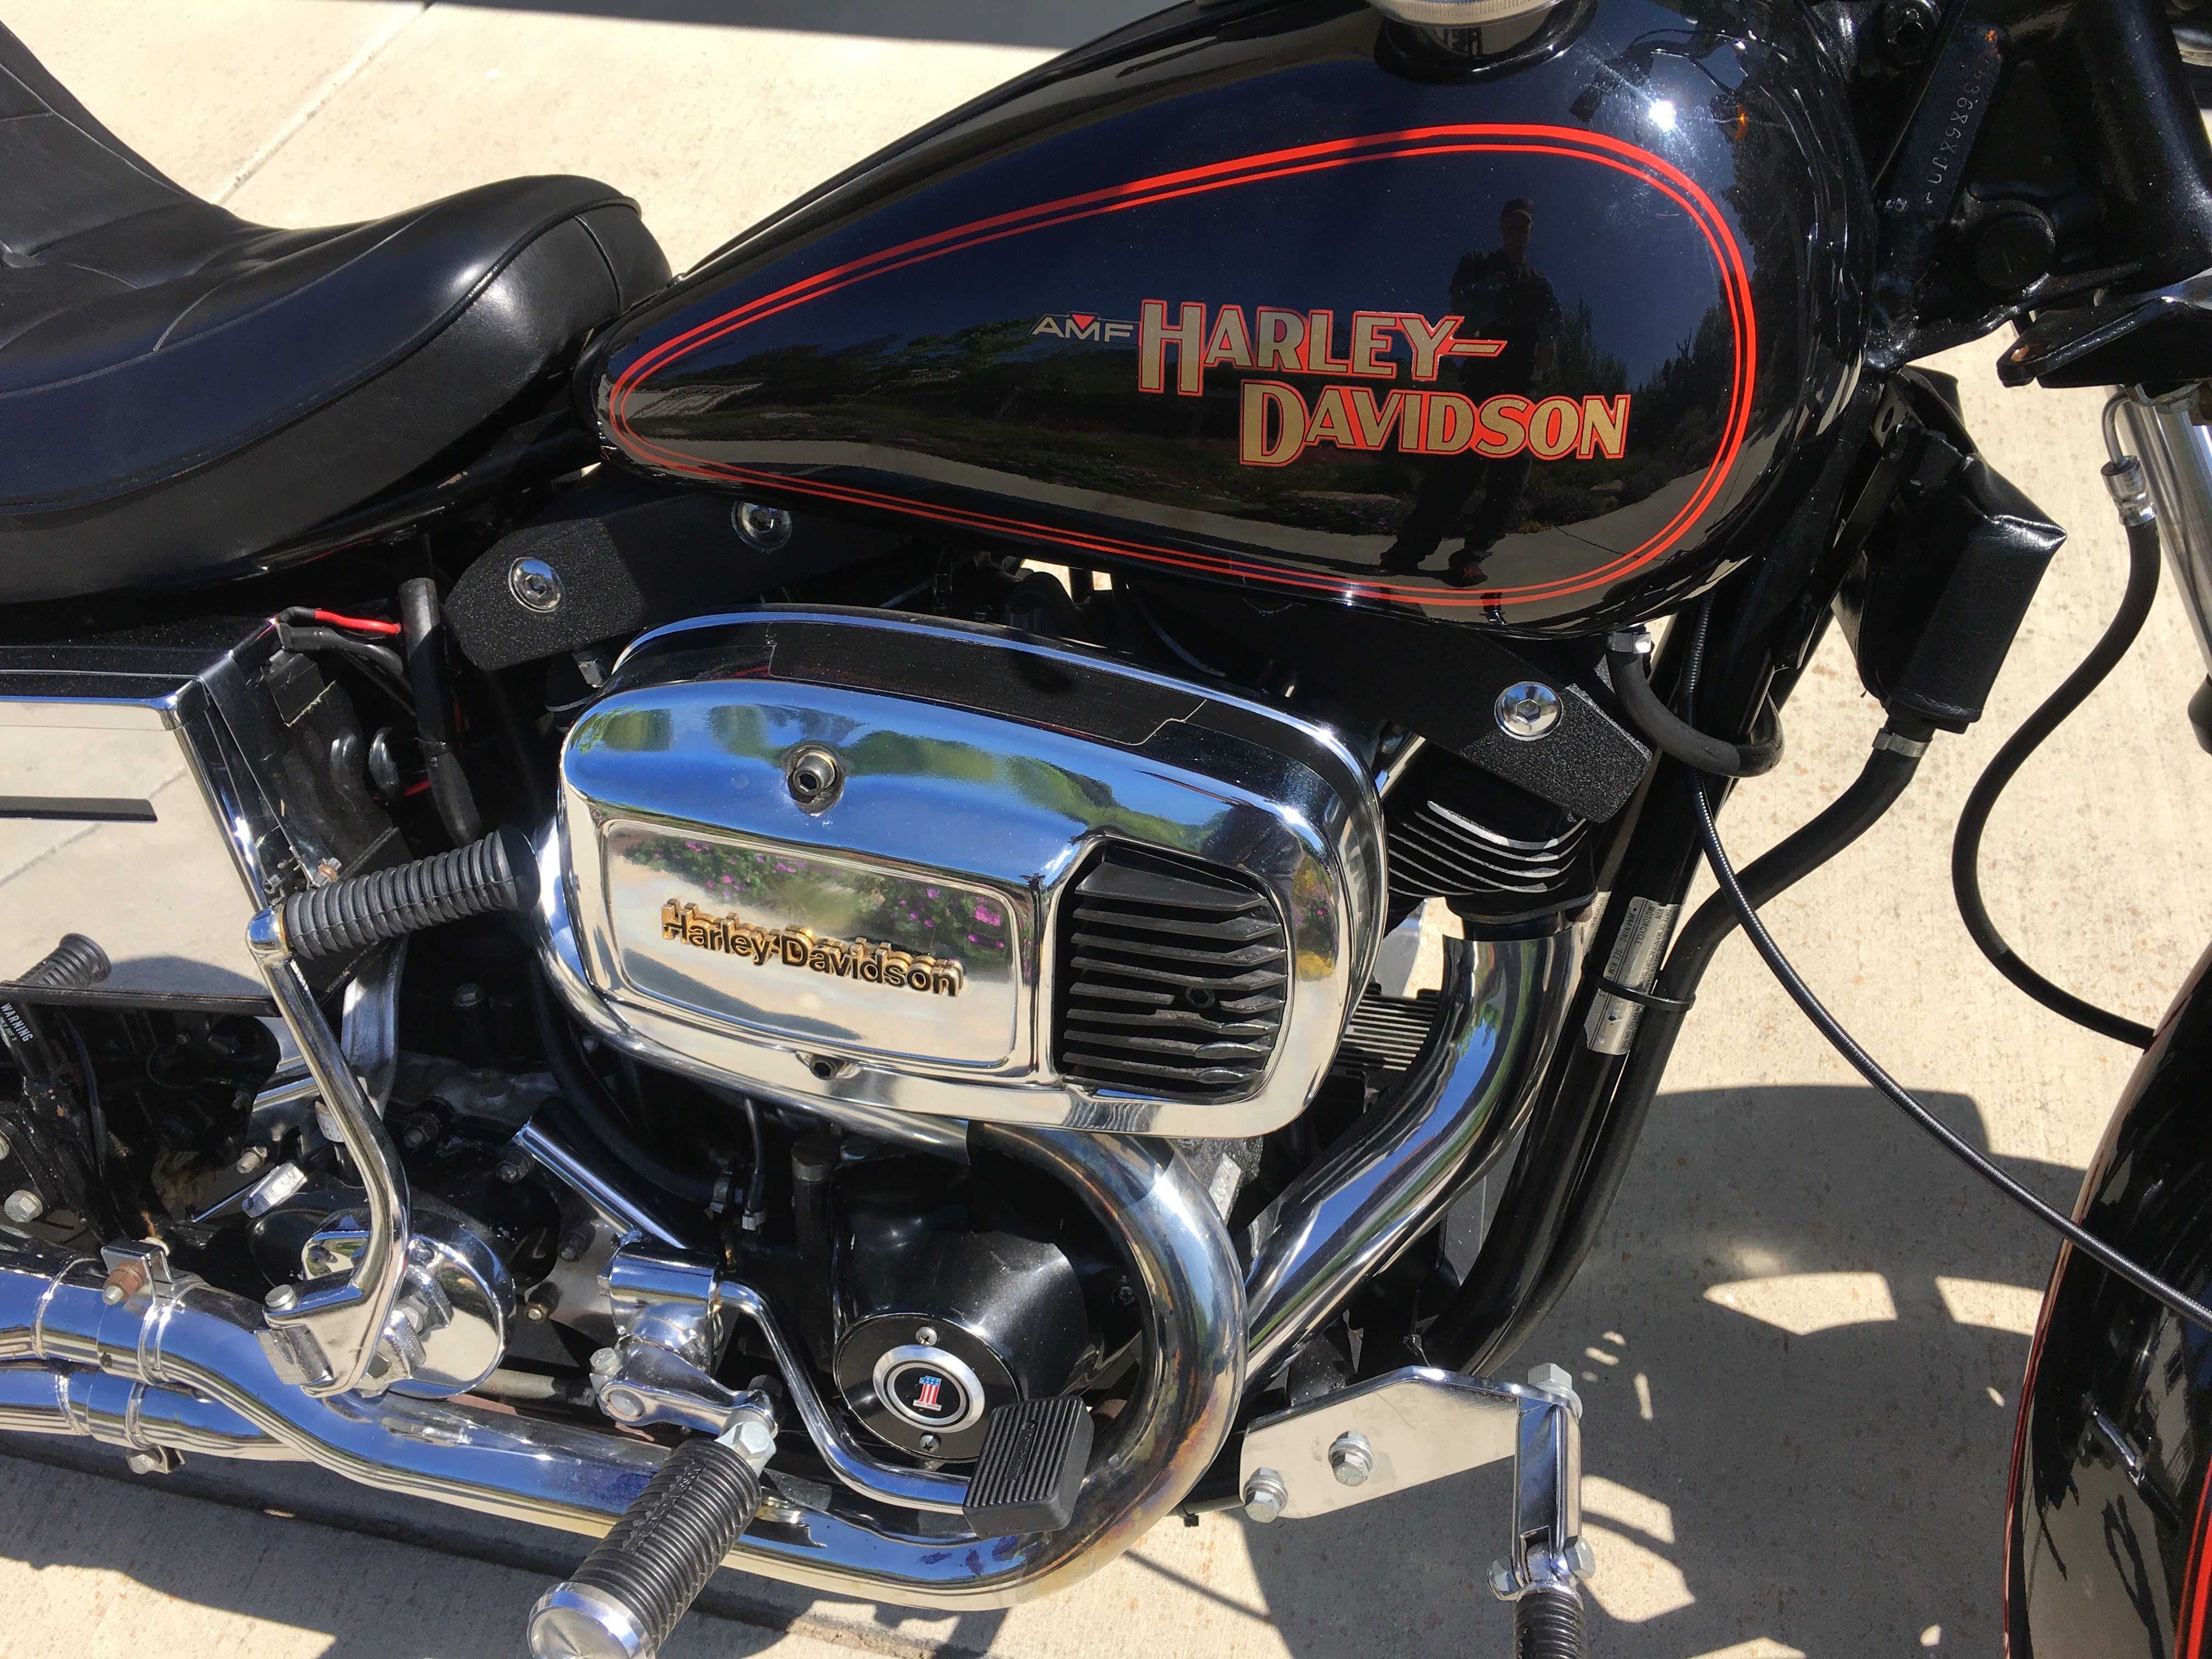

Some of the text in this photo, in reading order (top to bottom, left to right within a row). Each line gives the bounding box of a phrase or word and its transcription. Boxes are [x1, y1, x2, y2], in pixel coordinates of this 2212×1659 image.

[1030, 315, 1135, 342] AMF
[1239, 380, 1630, 467] DAVIDSON
[1619, 912, 1636, 942] WARNING
[1634, 905, 1655, 945] MOTORCYCLE
[1655, 907, 1663, 919] VIN
[1661, 909, 1671, 922] DATE
[1612, 948, 1622, 960] SEE
[1644, 932, 1663, 969] MANUFACTURE
[1607, 962, 1617, 974] RIM
[1, 1003, 33, 1042] WARNING
